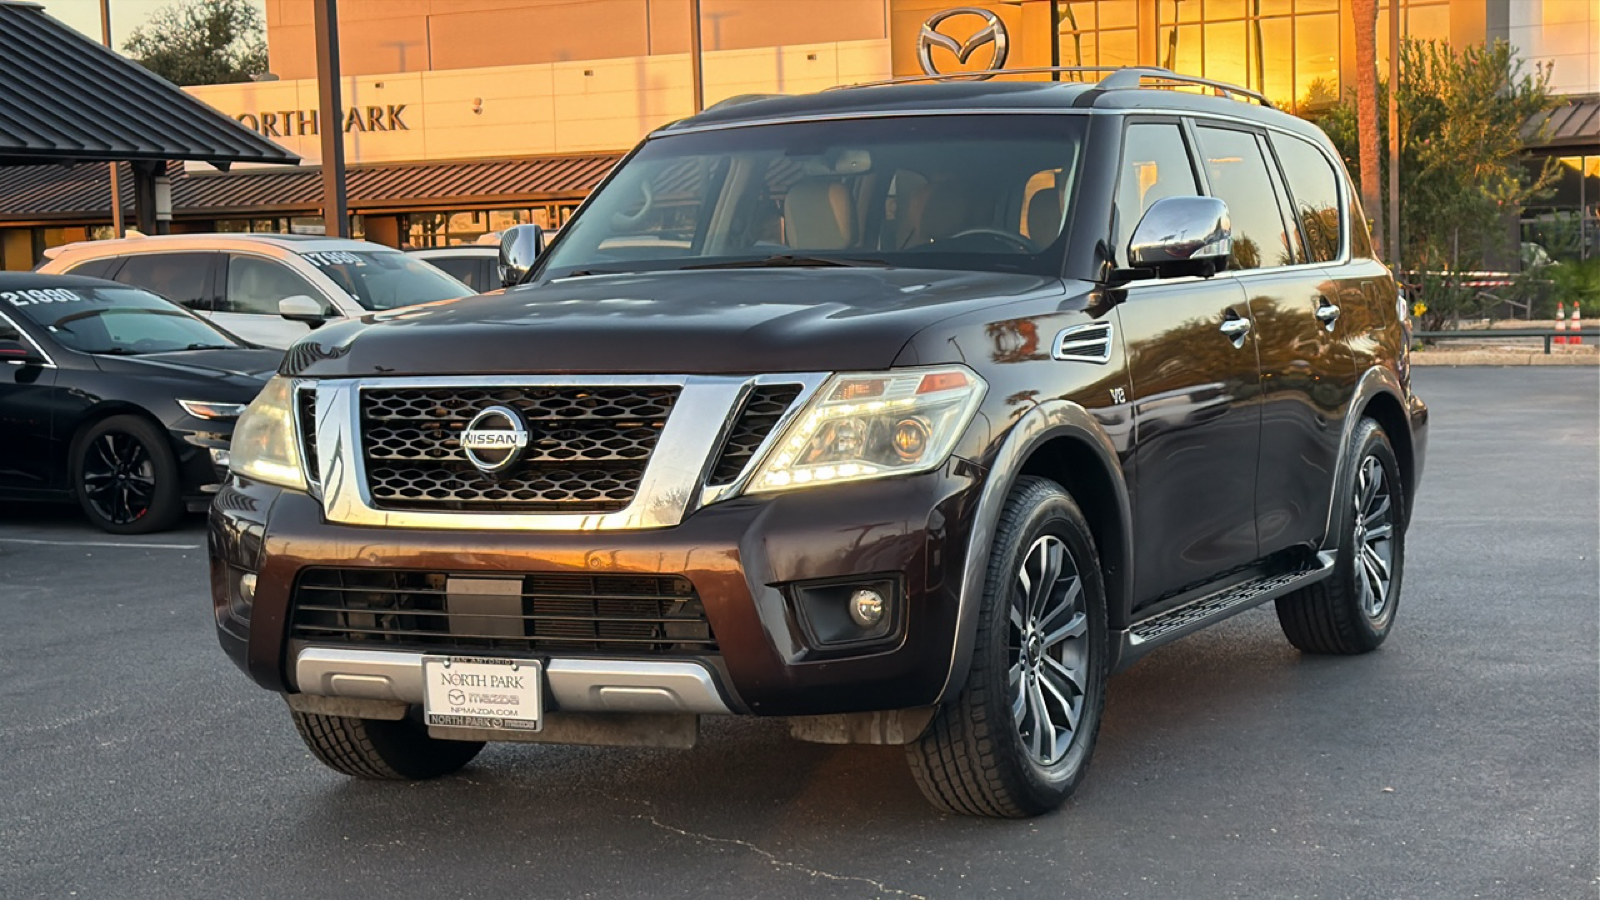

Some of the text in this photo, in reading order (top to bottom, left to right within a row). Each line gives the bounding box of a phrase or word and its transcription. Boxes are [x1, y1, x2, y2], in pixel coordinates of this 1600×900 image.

[233, 104, 410, 137] ORTH ARK
[0, 288, 81, 307] 21990
[1109, 387, 1127, 405] V8
[464, 433, 517, 445] NISSAN
[441, 672, 525, 689] NORTH PARK
[468, 693, 520, 705] mazda
[432, 715, 464, 726] NORTH
[465, 716, 491, 728] PARK
